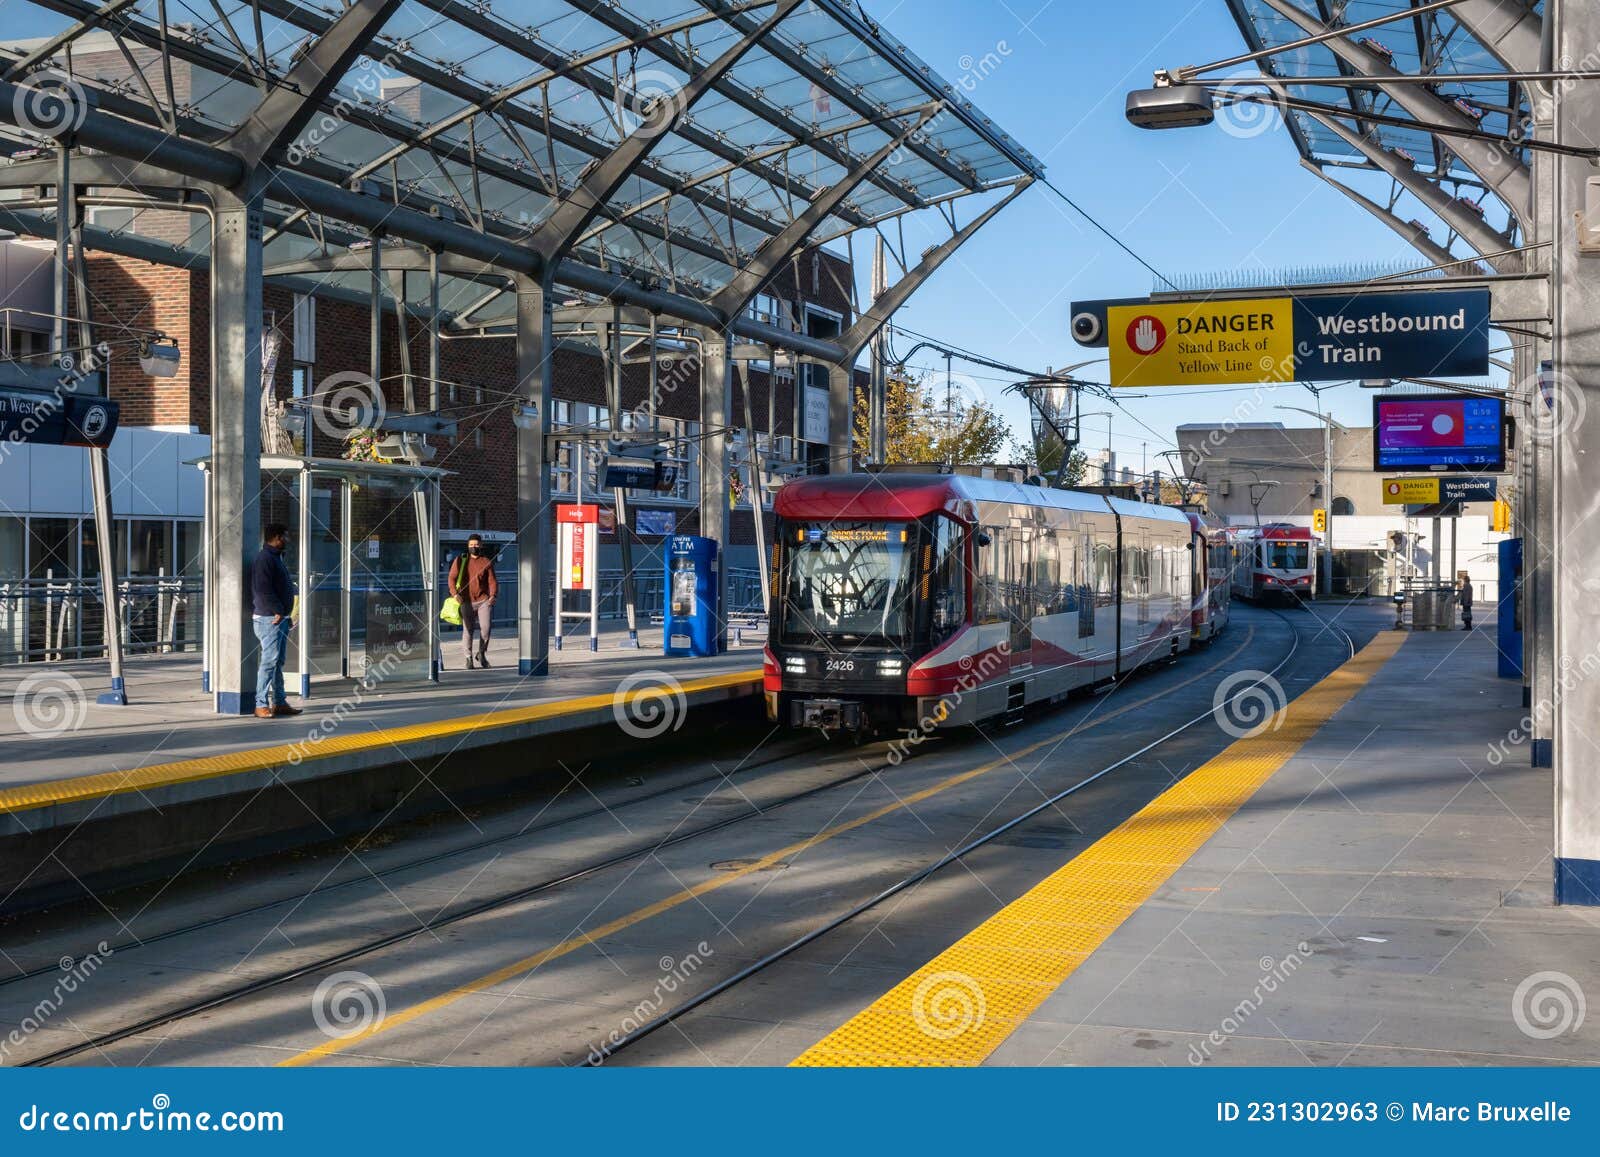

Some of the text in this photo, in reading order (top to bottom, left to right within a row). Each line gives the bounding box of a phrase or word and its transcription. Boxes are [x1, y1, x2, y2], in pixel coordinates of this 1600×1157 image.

[1177, 313, 1274, 334] DANGER
[1317, 309, 1465, 336] Westbound
[1177, 337, 1269, 354] Stand Back of
[1317, 343, 1382, 364] Train
[1178, 360, 1253, 374] Yellow Line
[1445, 482, 1490, 490] Westbound
[569, 510, 583, 518] Help
[671, 542, 695, 550] ATM
[374, 601, 425, 616] Free curbside
[826, 660, 855, 671] 2426
